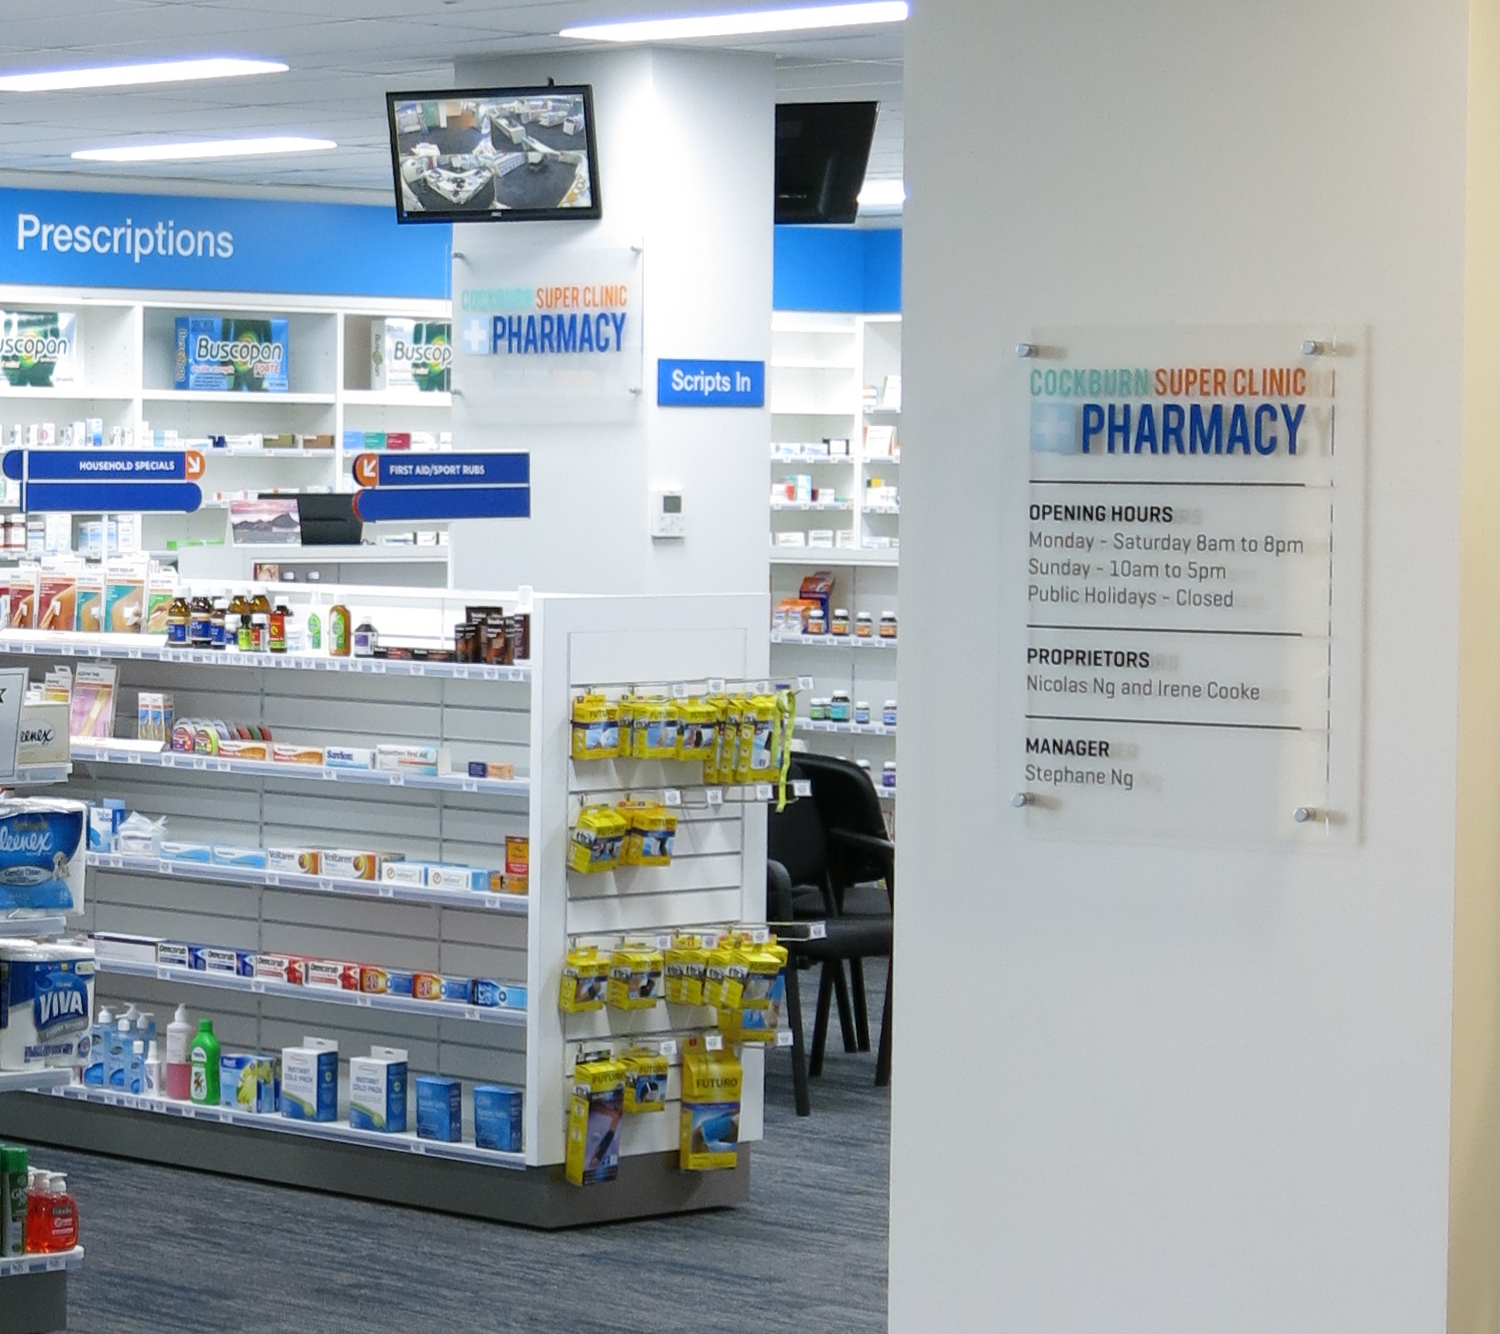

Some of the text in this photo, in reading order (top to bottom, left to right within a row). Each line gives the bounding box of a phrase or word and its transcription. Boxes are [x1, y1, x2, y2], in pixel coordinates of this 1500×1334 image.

[17, 213, 234, 263] Prescriptions
[536, 286, 579, 309] SUPER
[583, 284, 628, 308] CLINIC
[492, 312, 626, 354] PHARMACY
[197, 334, 283, 363] Buscopan
[253, 363, 280, 377] FORTE
[671, 369, 751, 395] Scripts In
[1029, 367, 1307, 396] COCKBURN SUPER CLINIC
[1082, 404, 1305, 455] PHARMACY
[79, 460, 175, 471] HOUSEHOLD SPECIALS
[389, 464, 485, 477] FIRST AID/SPORT RUBS
[1029, 504, 1173, 523] OPENING HOURS
[1029, 531, 1095, 554] Monday
[1113, 533, 1191, 554] Saturday
[1196, 535, 1236, 553] 8am
[1240, 537, 1259, 553] to
[1263, 536, 1304, 556] 8pm
[1028, 559, 1090, 581] Sunday
[1109, 560, 1160, 579] 10am
[1164, 563, 1182, 579] to
[1187, 562, 1227, 583] 5pm
[1028, 585, 1080, 604] Public
[1084, 586, 1157, 608] Holidays
[1176, 588, 1234, 609] Closed
[1027, 648, 1150, 669] PROPRIETORS
[1026, 675, 1260, 701] Nicolas Ng and Irene Cooke
[1025, 738, 1110, 757] MANAGER
[1025, 765, 1133, 790] Stephane Ng
[39, 990, 83, 1024] VIVA
[696, 1078, 738, 1089] FUTURO
